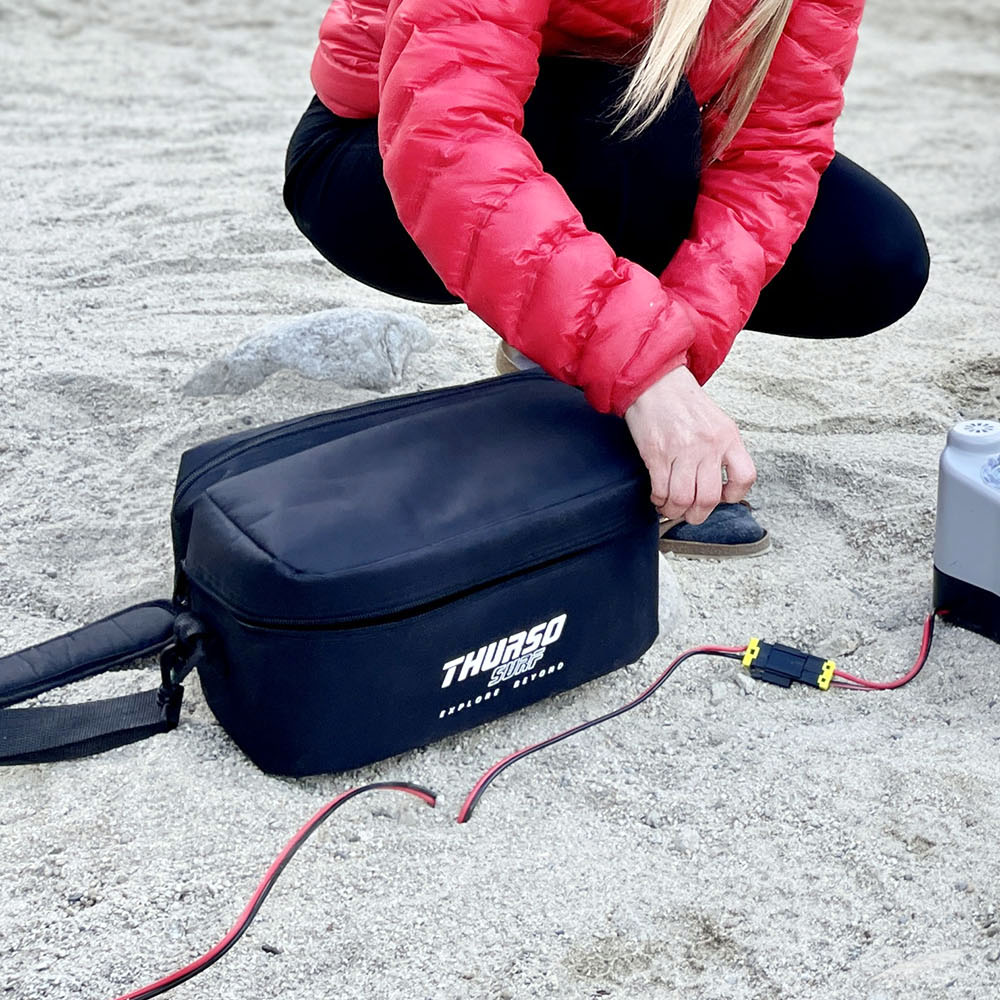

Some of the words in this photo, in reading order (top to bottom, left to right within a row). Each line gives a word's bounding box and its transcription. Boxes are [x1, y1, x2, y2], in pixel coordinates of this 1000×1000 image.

[441, 613, 567, 688] THURSO
[487, 646, 547, 687] SURF
[438, 688, 500, 718] EXPLORE
[513, 661, 564, 688] BEYOND
